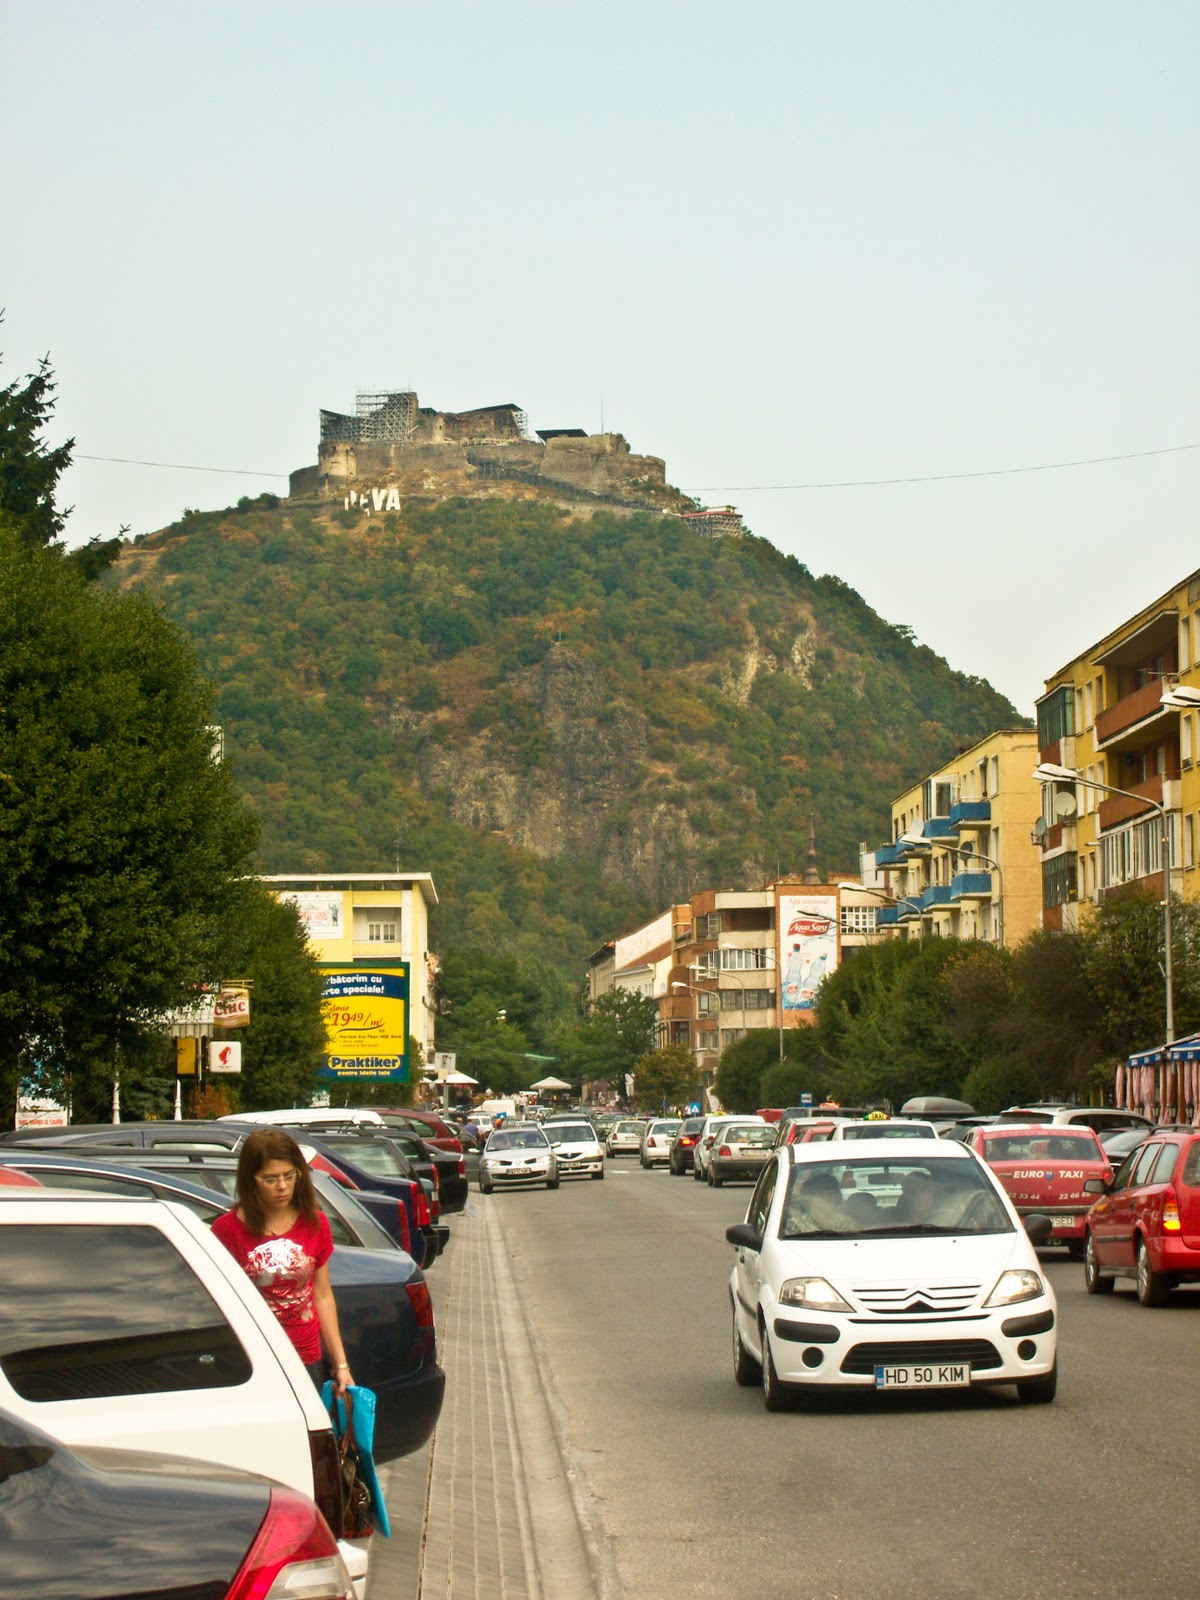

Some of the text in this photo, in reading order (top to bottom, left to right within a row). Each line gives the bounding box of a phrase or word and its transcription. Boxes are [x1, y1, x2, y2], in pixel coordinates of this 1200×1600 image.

[790, 922, 810, 933] Aqua
[324, 974, 382, 985] rbătorim cu
[343, 984, 385, 995] speciale!
[331, 1057, 398, 1068] Praktiker
[1013, 1170, 1044, 1179] EURO
[1058, 1170, 1084, 1179] TAXI
[1058, 1192, 1069, 1200] 22
[885, 1366, 964, 1384] HD 50 KIM
